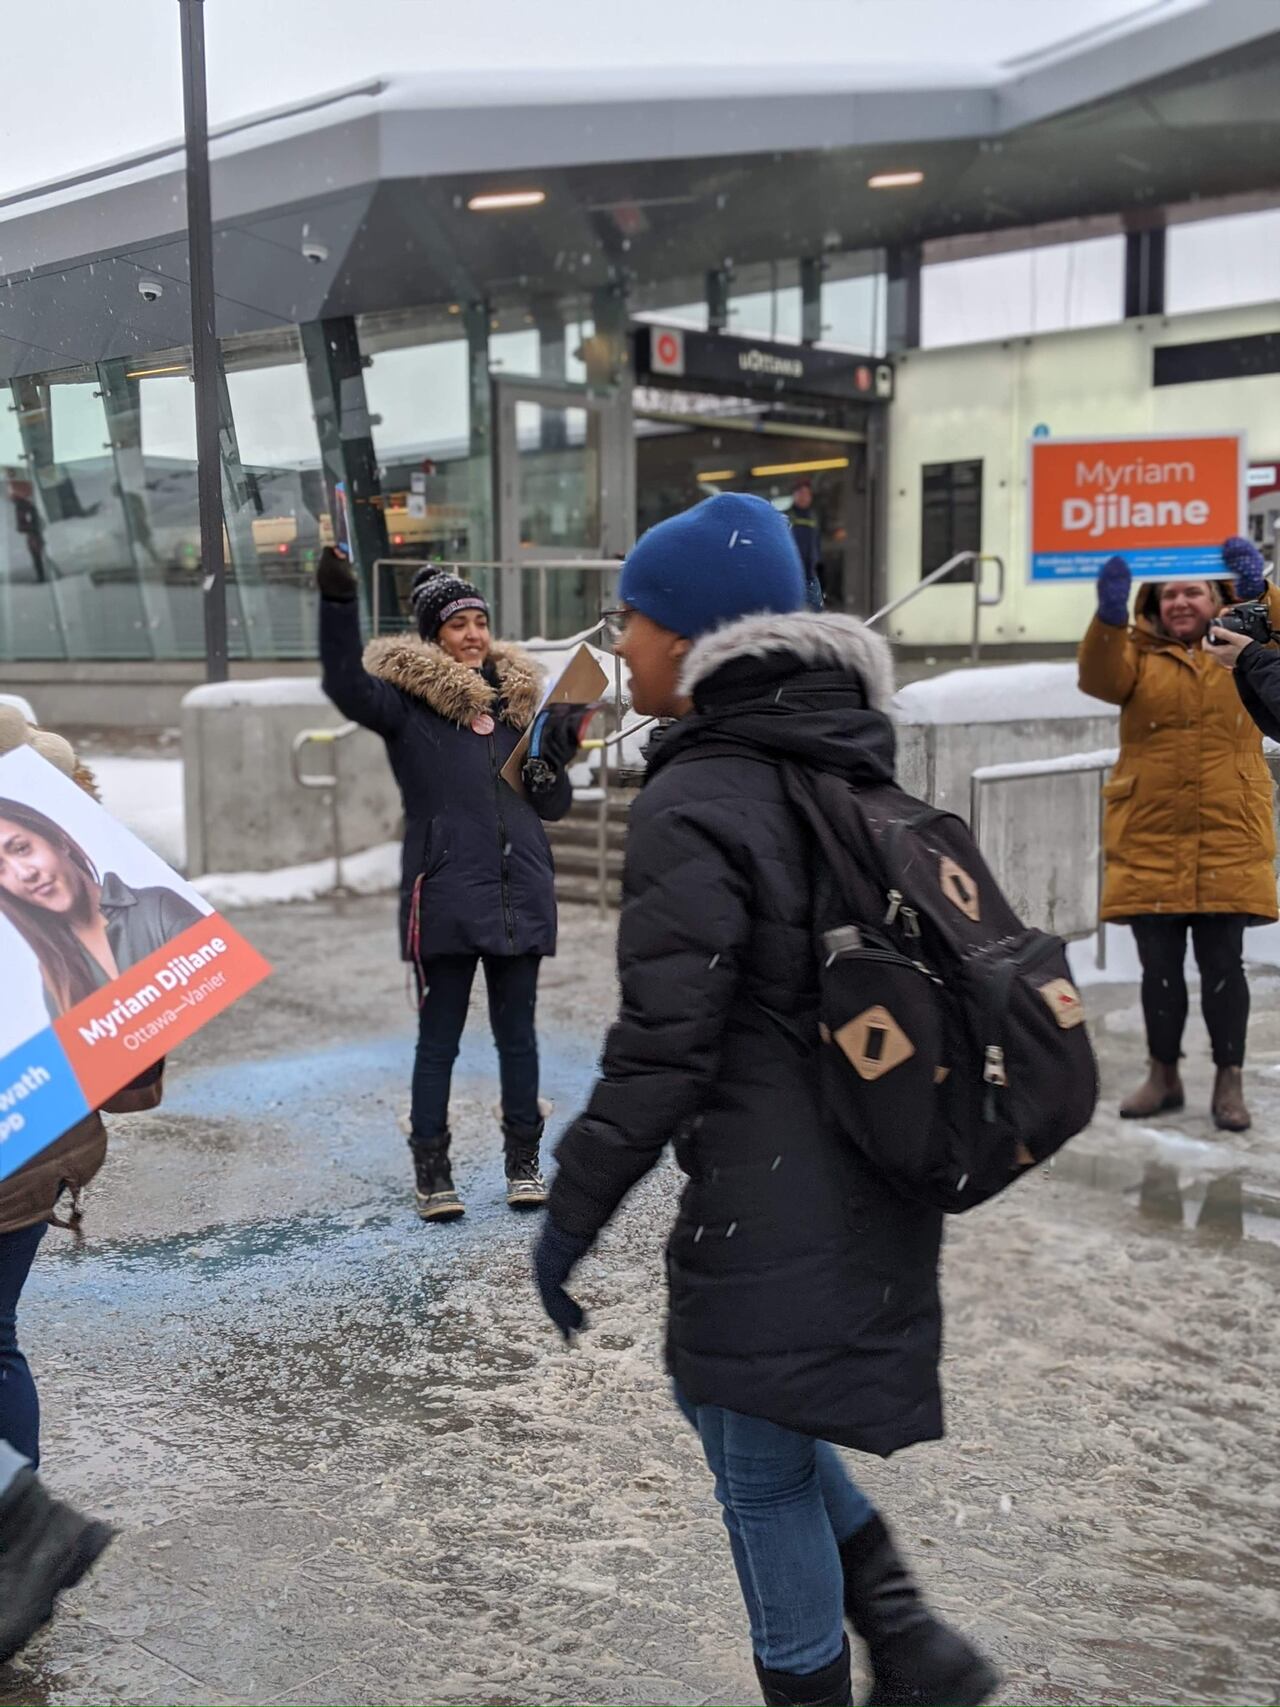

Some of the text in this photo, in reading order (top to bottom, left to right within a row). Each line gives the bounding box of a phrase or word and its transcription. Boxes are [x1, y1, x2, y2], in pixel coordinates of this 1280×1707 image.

[1076, 457, 1195, 491] Myriam
[1061, 493, 1210, 537] Djilane
[78, 936, 228, 1045] Myriam Djilane
